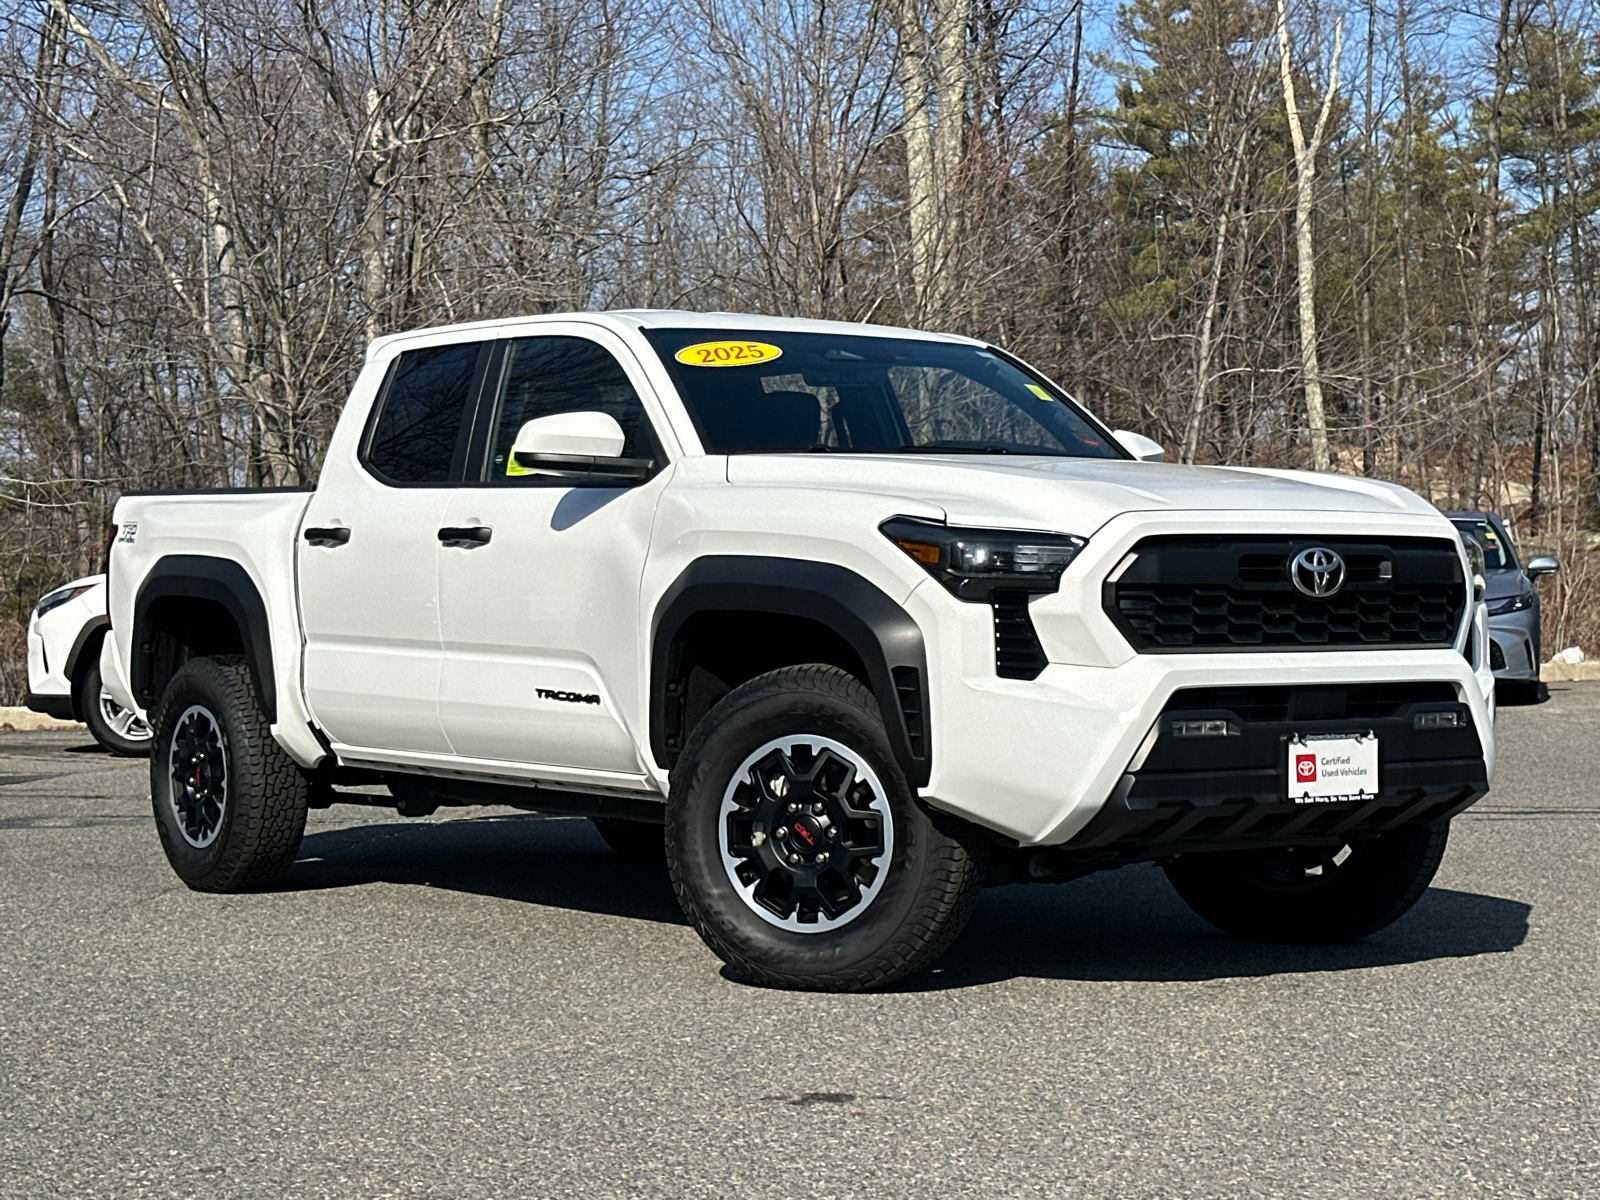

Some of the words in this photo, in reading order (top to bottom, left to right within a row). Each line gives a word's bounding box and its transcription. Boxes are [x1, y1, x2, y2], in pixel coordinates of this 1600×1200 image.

[697, 345, 764, 363] 2025
[535, 688, 601, 705] TACOMA
[1321, 756, 1351, 766] Certified
[1322, 769, 1339, 777] Used
[1340, 767, 1367, 777] Vehicles
[794, 822, 814, 845] TRD
